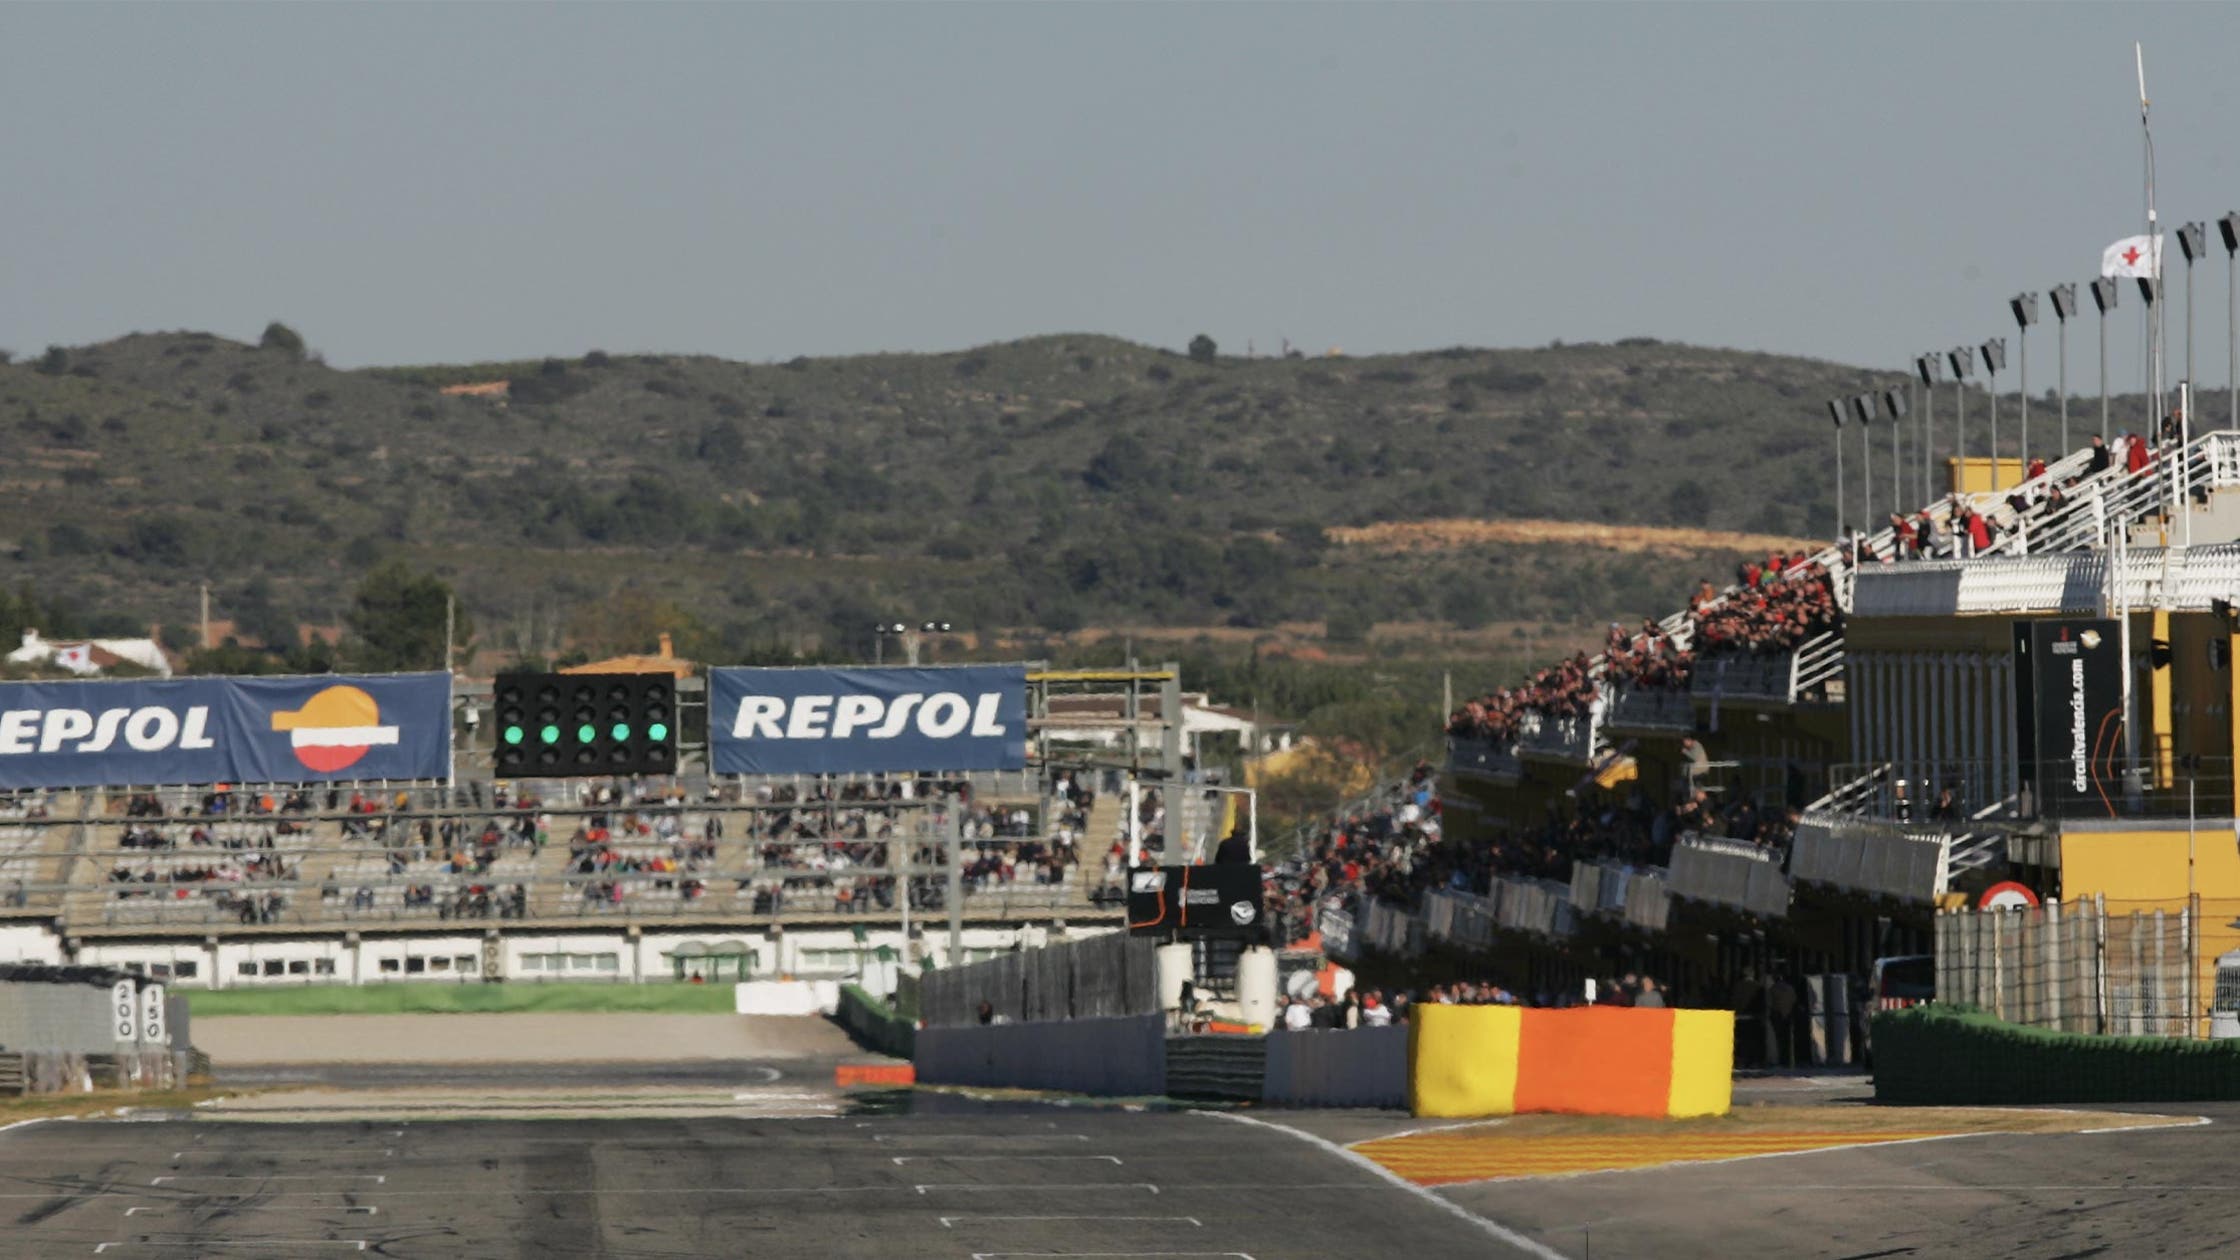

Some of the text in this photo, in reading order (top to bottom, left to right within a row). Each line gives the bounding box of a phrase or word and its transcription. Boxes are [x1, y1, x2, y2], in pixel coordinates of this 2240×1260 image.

[0, 706, 214, 753] EPSOL
[732, 692, 1006, 738] REPSOL
[2070, 658, 2087, 793] circuitvalencia.com
[118, 984, 131, 1036] 200
[147, 989, 160, 1037] 150
